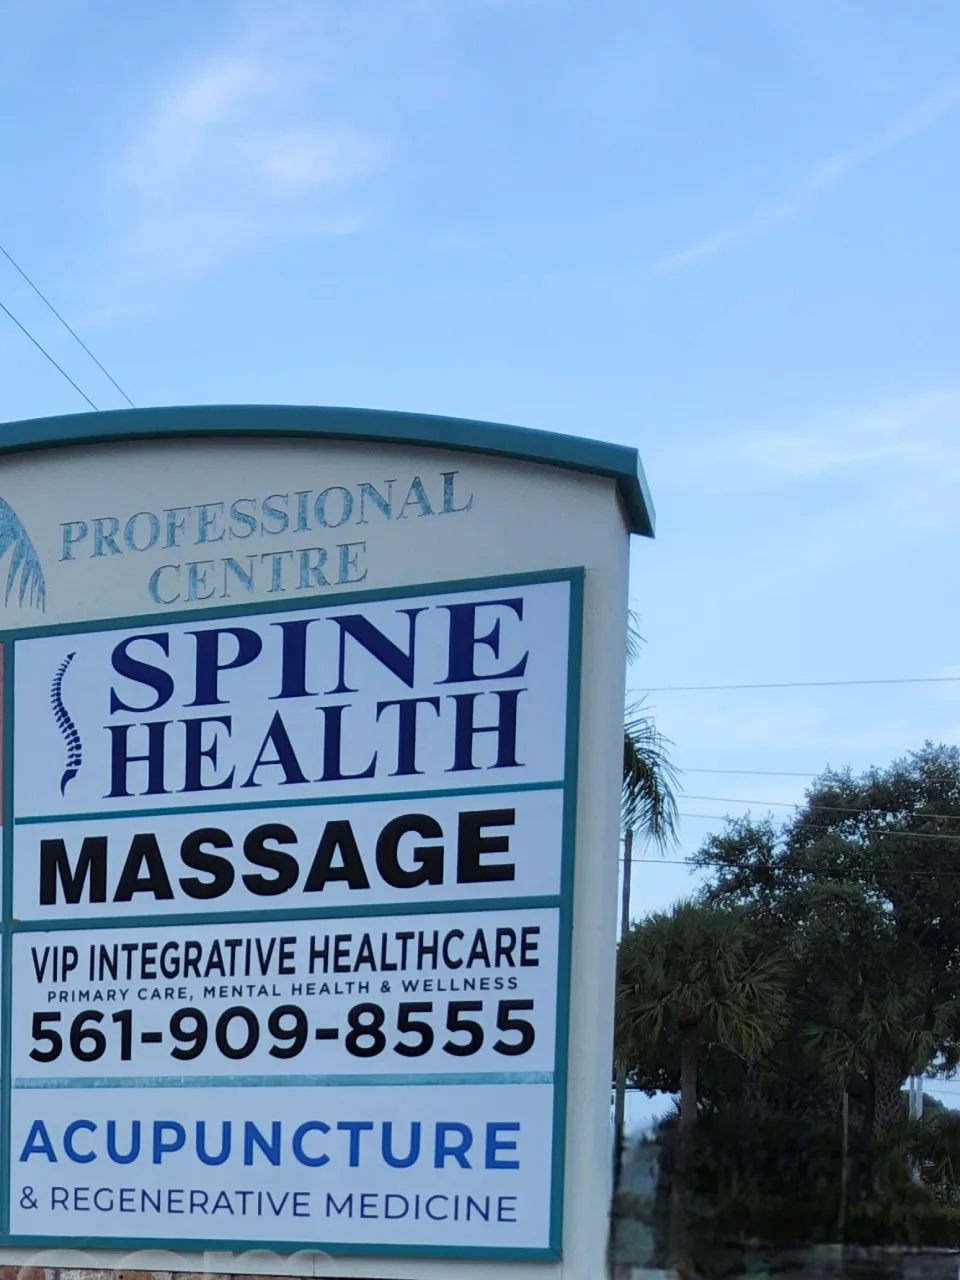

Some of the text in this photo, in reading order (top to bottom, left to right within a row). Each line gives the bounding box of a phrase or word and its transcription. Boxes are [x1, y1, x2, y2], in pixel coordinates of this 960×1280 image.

[59, 471, 474, 561] PROFESSIONAL
[148, 542, 368, 604] CENTRE
[110, 597, 530, 715] SPINE
[102, 689, 528, 799] HEALTH
[39, 808, 516, 906] MASSAGE
[31, 926, 541, 983] VIP INTEGRATIVE HEALTHCARE
[47, 976, 519, 1003] PRIMARY CARE, MENTAL HEALTH & WELLNESS
[29, 999, 536, 1063] 561-909-8555
[19, 1118, 521, 1170] ACUPUNCTURE
[19, 1186, 519, 1223] & REGENERATIVE MEDICINE
